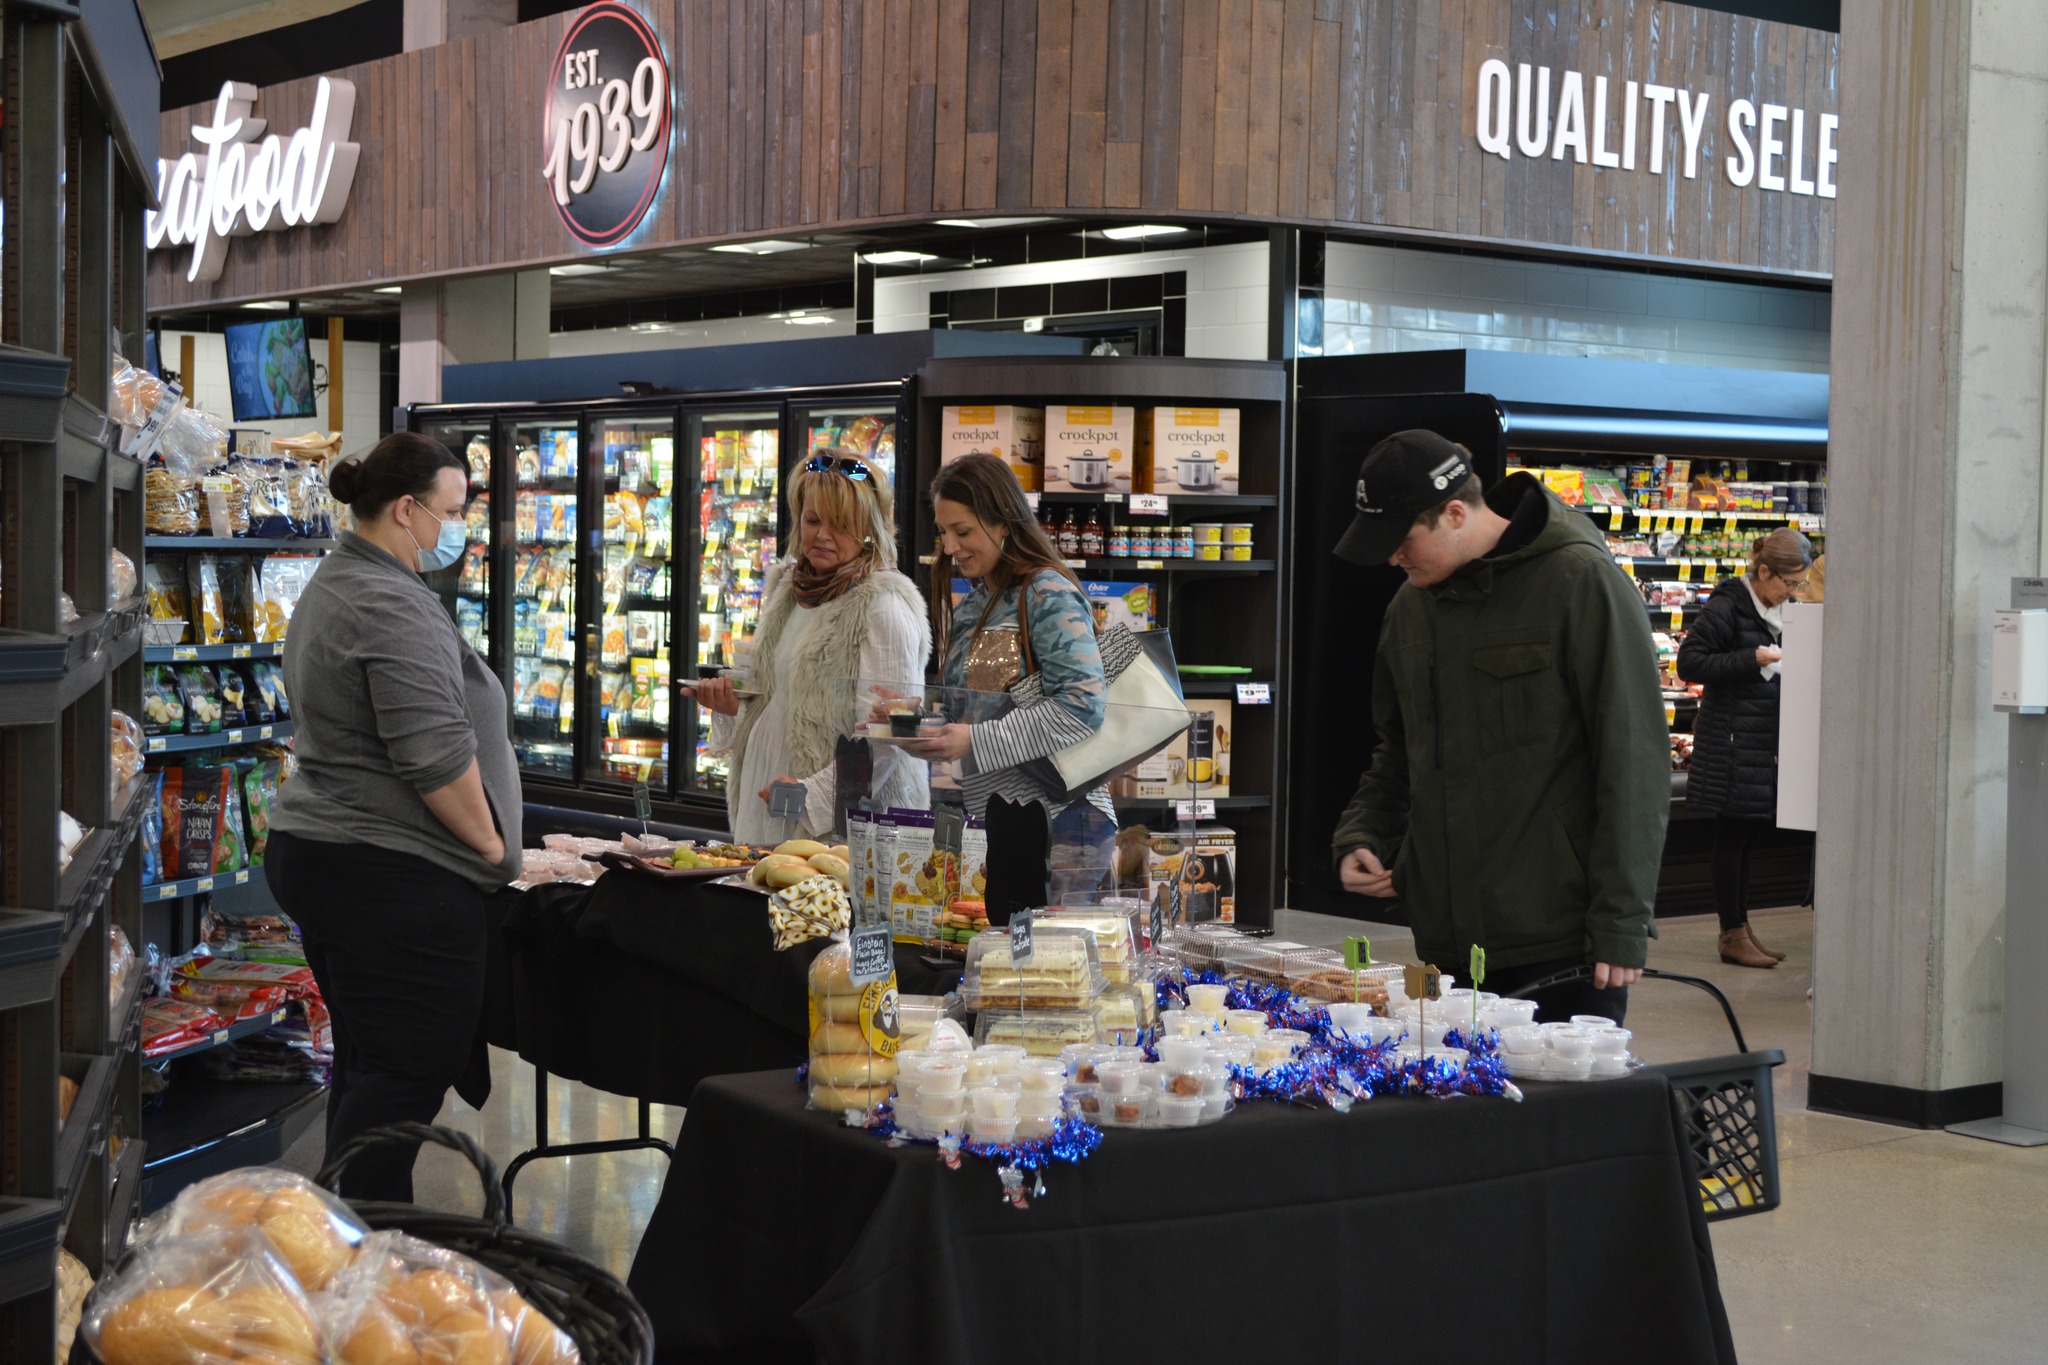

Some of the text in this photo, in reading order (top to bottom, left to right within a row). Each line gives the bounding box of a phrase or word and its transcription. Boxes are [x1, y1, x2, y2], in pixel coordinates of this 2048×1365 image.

[565, 49, 604, 90] EST.
[543, 57, 665, 206] 1939
[1476, 59, 1838, 199] QUALITY SELE
[952, 428, 1000, 443] crockpot
[1059, 429, 1119, 444] crockpot
[1168, 430, 1226, 445] crockpot
[1088, 583, 1110, 592] Oster
[177, 795, 222, 813] Stonefire
[187, 817, 213, 828] NAAN
[186, 829, 212, 840] CRISPS
[856, 936, 884, 950] Einstein
[855, 946, 887, 959] Plain Bagel
